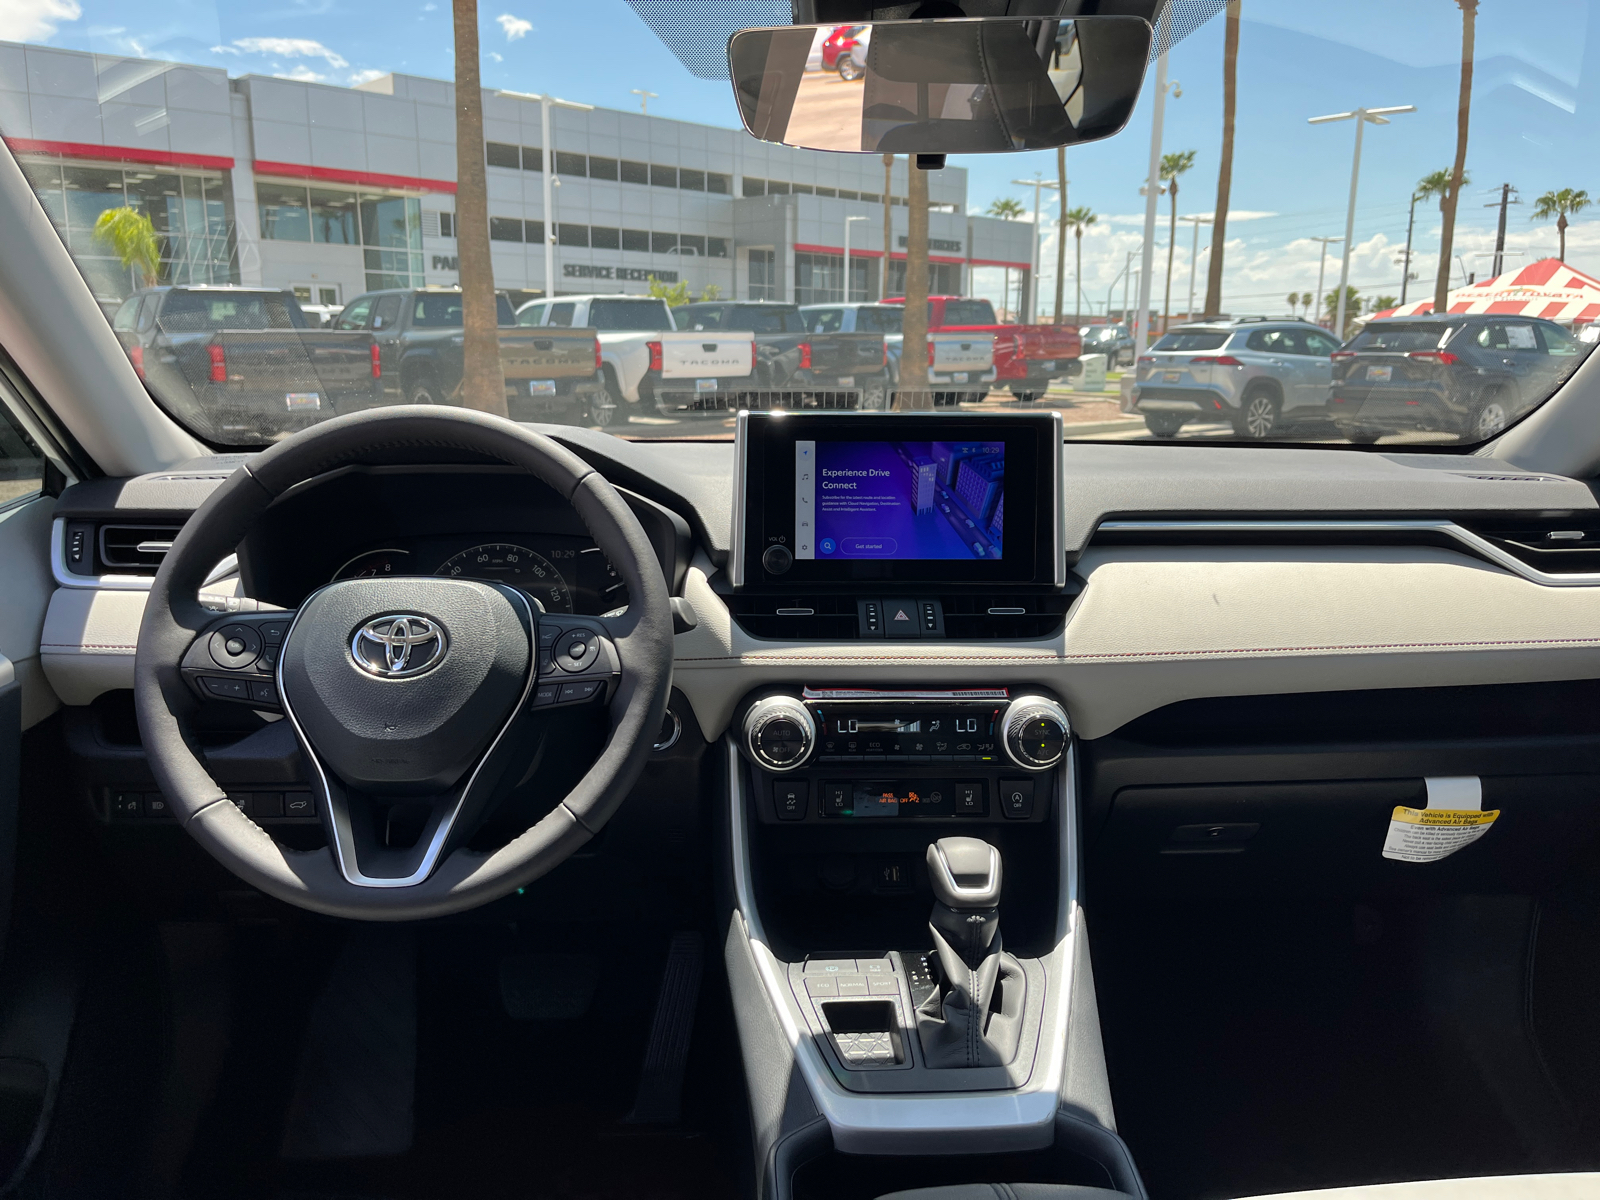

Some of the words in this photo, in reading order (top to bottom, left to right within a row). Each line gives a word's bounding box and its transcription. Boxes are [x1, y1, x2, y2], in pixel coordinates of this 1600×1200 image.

[563, 263, 614, 280] SERVICE
[616, 267, 679, 284] RECEPTION
[1522, 291, 1584, 299] TOYOTA
[822, 468, 868, 479] Experience
[869, 468, 891, 478] Drive
[822, 481, 857, 490] Connect
[477, 553, 489, 563] 60
[507, 553, 519, 563] 80
[551, 550, 575, 558] 10:29
[385, 563, 391, 572] 8
[450, 565, 462, 577] 40
[531, 564, 546, 578] 100
[370, 569, 377, 577] 7
[549, 586, 561, 602] 120
[1403, 809, 1419, 817] This
[1421, 811, 1444, 819] Vehicle
[1452, 812, 1482, 820] Equipped
